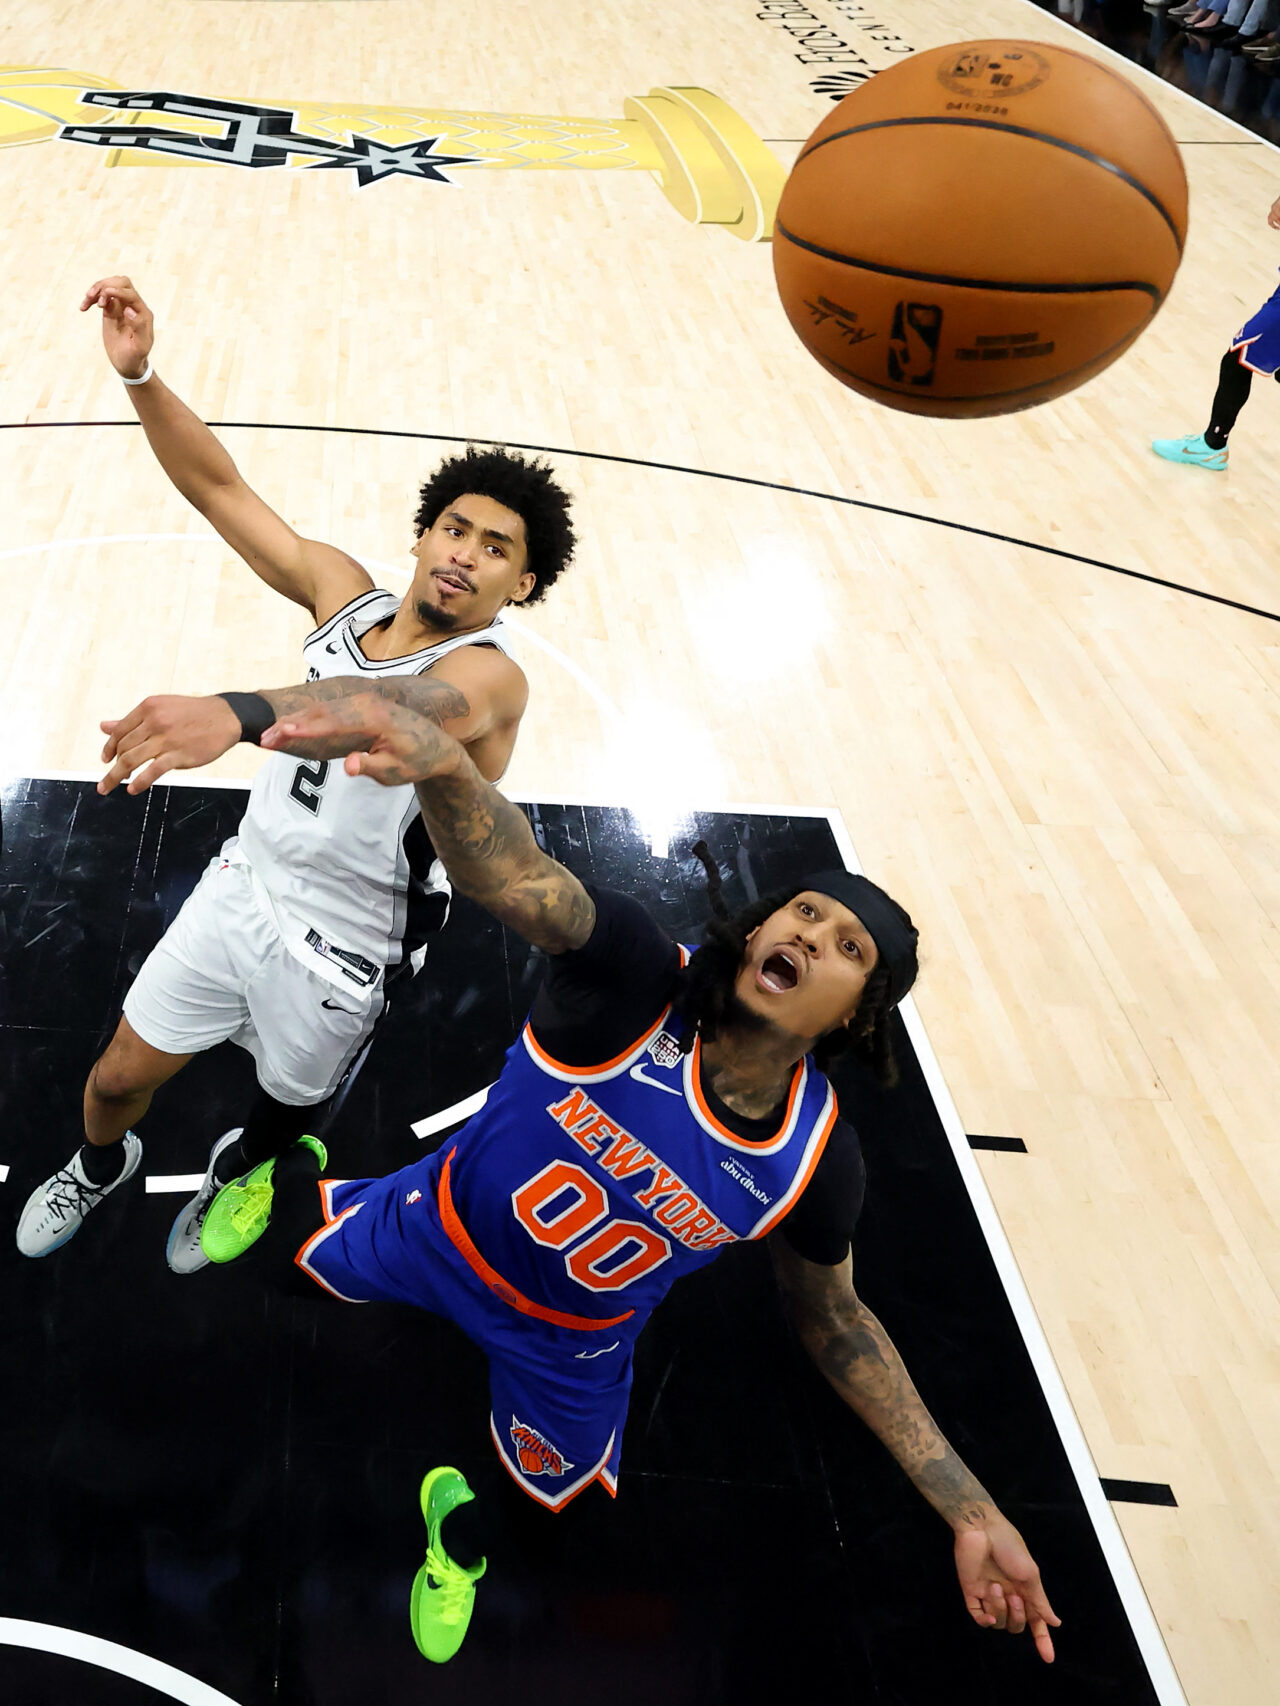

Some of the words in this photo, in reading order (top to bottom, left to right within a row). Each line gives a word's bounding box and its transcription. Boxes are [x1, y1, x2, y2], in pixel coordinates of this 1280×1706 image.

[827, 0, 916, 52] CENTE
[287, 757, 331, 818] 2
[546, 1085, 658, 1181] NEW
[631, 1163, 745, 1251] YORK
[720, 1161, 741, 1180] abu
[740, 1176, 773, 1205] dhabi
[511, 1158, 672, 1293] 00
[511, 1427, 562, 1474] KNICKS
